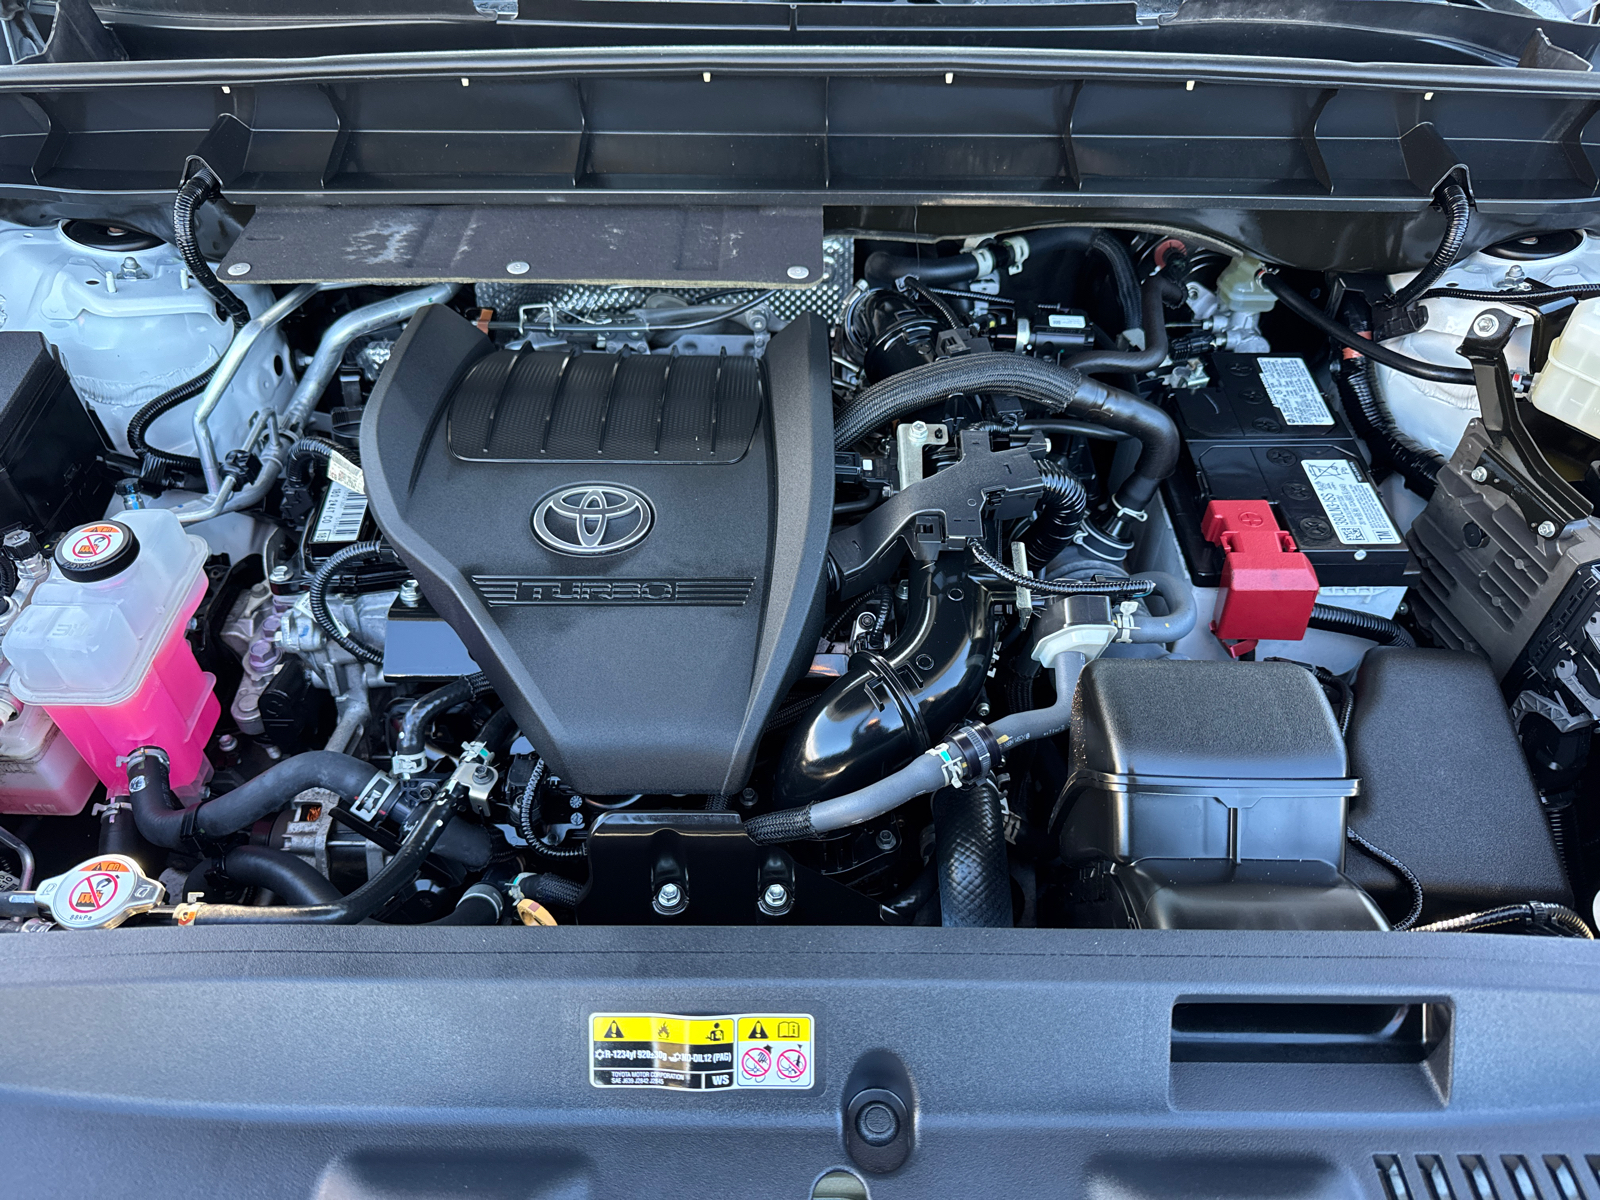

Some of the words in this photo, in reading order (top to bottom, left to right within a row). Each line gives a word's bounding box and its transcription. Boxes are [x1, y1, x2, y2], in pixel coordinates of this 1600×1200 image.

[521, 582, 673, 600] TURBO
[712, 1052, 732, 1063] (PAG)
[650, 1071, 685, 1080] CORPORATION
[711, 1074, 730, 1085] WS
